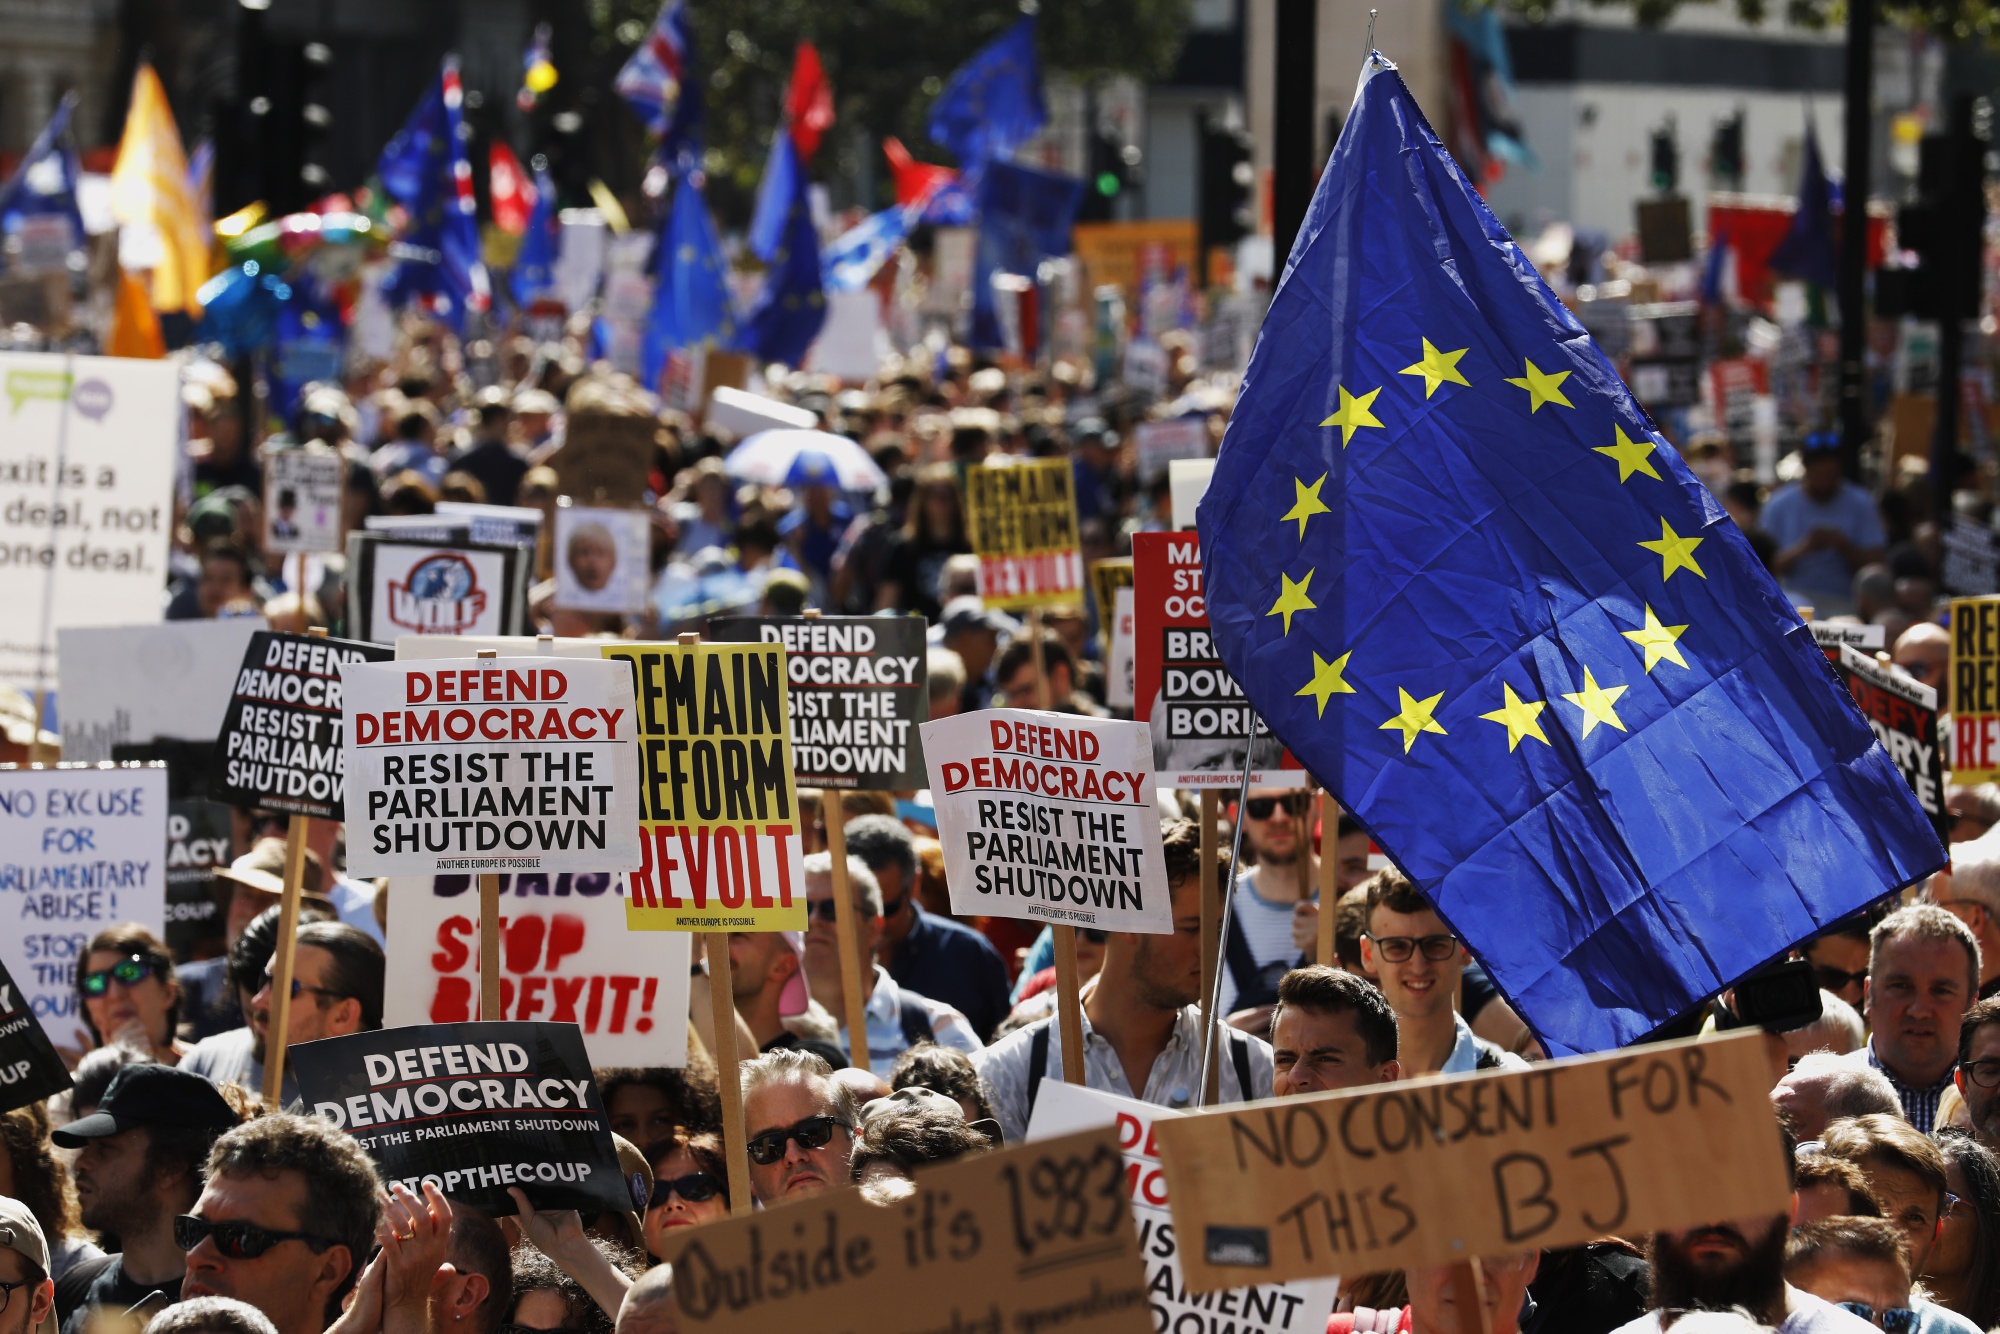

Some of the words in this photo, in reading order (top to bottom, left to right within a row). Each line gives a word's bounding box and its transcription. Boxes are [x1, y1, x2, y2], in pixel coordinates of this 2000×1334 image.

[0, 455, 47, 486] xit
[57, 454, 86, 488] is
[97, 467, 116, 488] a
[975, 467, 1067, 508] REMAIN
[4, 496, 90, 532] deal,
[102, 506, 161, 532] not
[982, 551, 1077, 598] REVOLT
[760, 625, 876, 653] DEFEND
[1815, 630, 1866, 644] Worker
[236, 668, 343, 710] DEMOCR
[406, 669, 568, 704] DEFEND
[788, 656, 920, 685] OCRACY
[1167, 670, 1245, 697] DOW
[611, 653, 782, 735] EMAIN
[787, 691, 833, 718] SIST
[840, 692, 896, 718] THE
[1851, 673, 1929, 742] DEFY
[240, 704, 322, 742] RESIST
[356, 707, 625, 745] DEMOCRACY
[790, 719, 911, 746] LIAMENT
[990, 719, 1099, 762] DEFEND
[227, 731, 345, 775] PARLIAME
[792, 747, 907, 773] TDOWN
[1874, 717, 1934, 777] ORY
[226, 760, 344, 802] SHUTDO
[384, 753, 510, 785] RESIST
[521, 752, 594, 783] THE
[638, 739, 790, 820] EFORM
[941, 757, 1146, 804] DEMOCRACY
[1178, 775, 1206, 784] ANOTHER
[1207, 775, 1228, 783] EUROPE
[1230, 774, 1236, 783] IS
[1236, 774, 1262, 783] POIBLE
[0, 789, 36, 819] NO
[46, 787, 145, 818] EXCUSE
[368, 785, 613, 821] PARLIAMENT
[978, 799, 1063, 838] RESIST
[1072, 810, 1127, 844] THE
[42, 826, 96, 854] FOR
[373, 820, 606, 855] SHUTDOWN
[966, 831, 1143, 878] PARLIAMENT
[0, 860, 150, 893] RLIAMENTARY
[436, 860, 470, 870] ANOTHER
[471, 859, 499, 869] EUROPE
[499, 859, 506, 868] IS
[508, 858, 541, 869] POSSIBLE
[629, 824, 795, 910] REVOLT
[974, 864, 1143, 911] SHUTDOWN
[676, 917, 699, 926] ANOTHER
[700, 917, 721, 926] EUROPE
[729, 917, 755, 926] POSSIBLE
[1028, 905, 1048, 917] ANOTHER
[1049, 909, 1067, 919] EUROPE
[1073, 912, 1096, 923] POSSIBLE
[26, 993, 81, 1018] OUP
[363, 1043, 529, 1087] DEFEND
[313, 1078, 590, 1132] DEMOCRACY
[1229, 1102, 1328, 1173] NO
[1340, 1067, 1570, 1159] CONSENT
[1607, 1048, 1734, 1120] FOR
[381, 1131, 412, 1147] THE
[415, 1120, 511, 1142] PARLIAMENT
[515, 1119, 600, 1133] SHUTDOWN
[386, 1162, 592, 1201] STOPTHECOUP
[1277, 1183, 1418, 1263] THIS
[671, 1210, 877, 1322] Outside
[903, 1188, 983, 1268] it's
